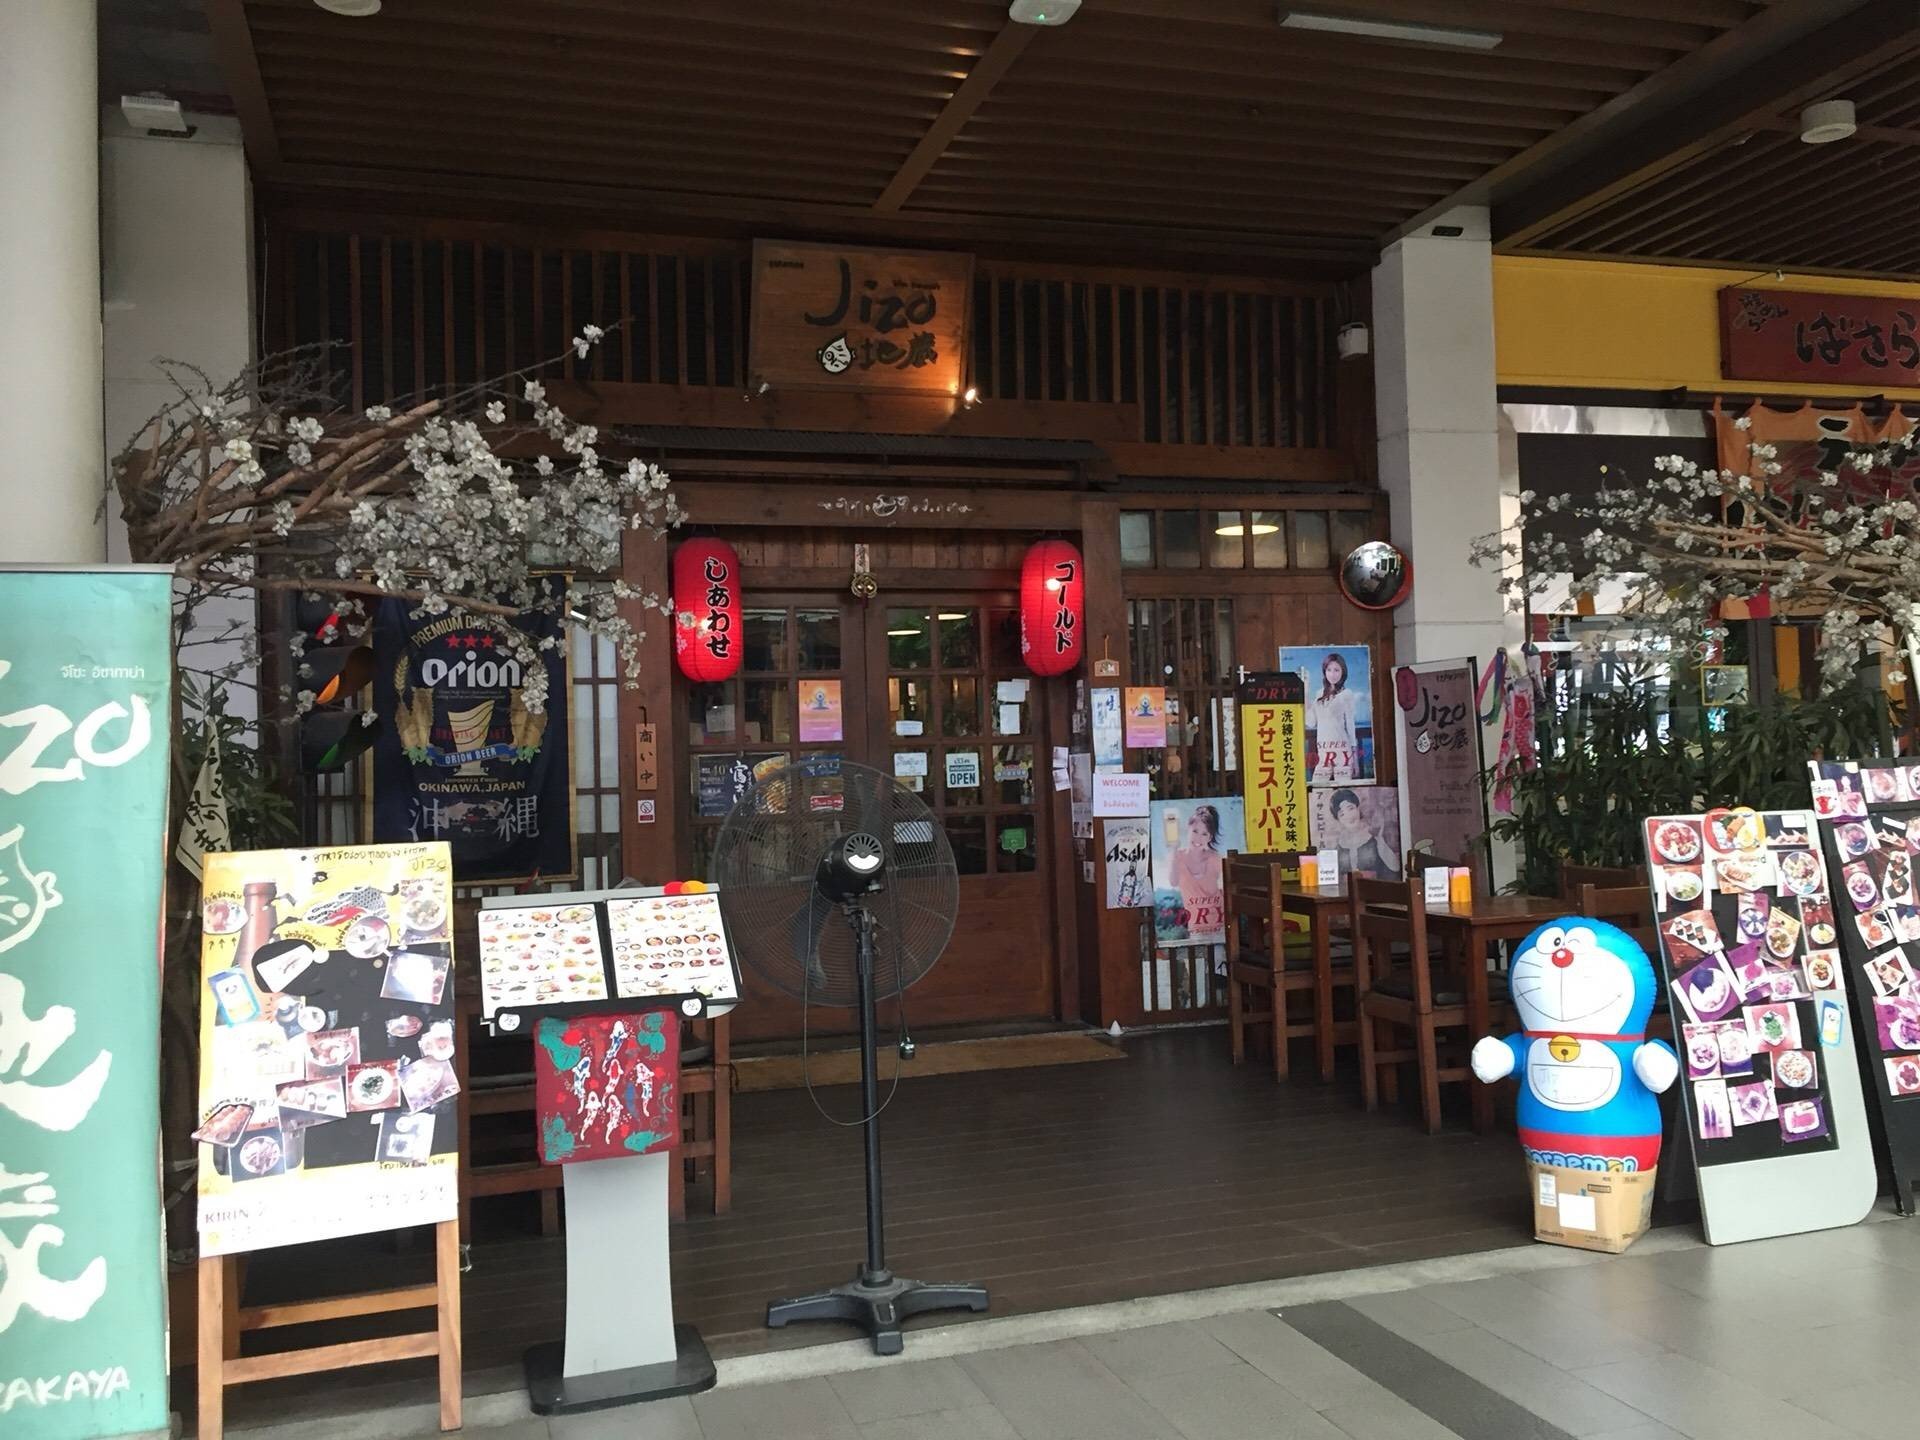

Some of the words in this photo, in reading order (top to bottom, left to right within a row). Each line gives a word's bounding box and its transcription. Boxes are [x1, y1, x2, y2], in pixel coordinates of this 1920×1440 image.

[804, 258, 937, 334] Jizo
[704, 556, 730, 659] しあわせ
[1053, 560, 1076, 654] ゴールド
[411, 615, 463, 648] PREMIUM
[1409, 687, 1467, 729] Jizo
[445, 752, 473, 765] ORION
[475, 747, 497, 759] BEER
[639, 729, 655, 785] 商い中
[1316, 741, 1348, 749] SUPER
[950, 773, 976, 785] OPEN
[1102, 779, 1139, 787] WELCOME
[1189, 896, 1220, 906] SUPER
[205, 1209, 249, 1225] KIRIN
